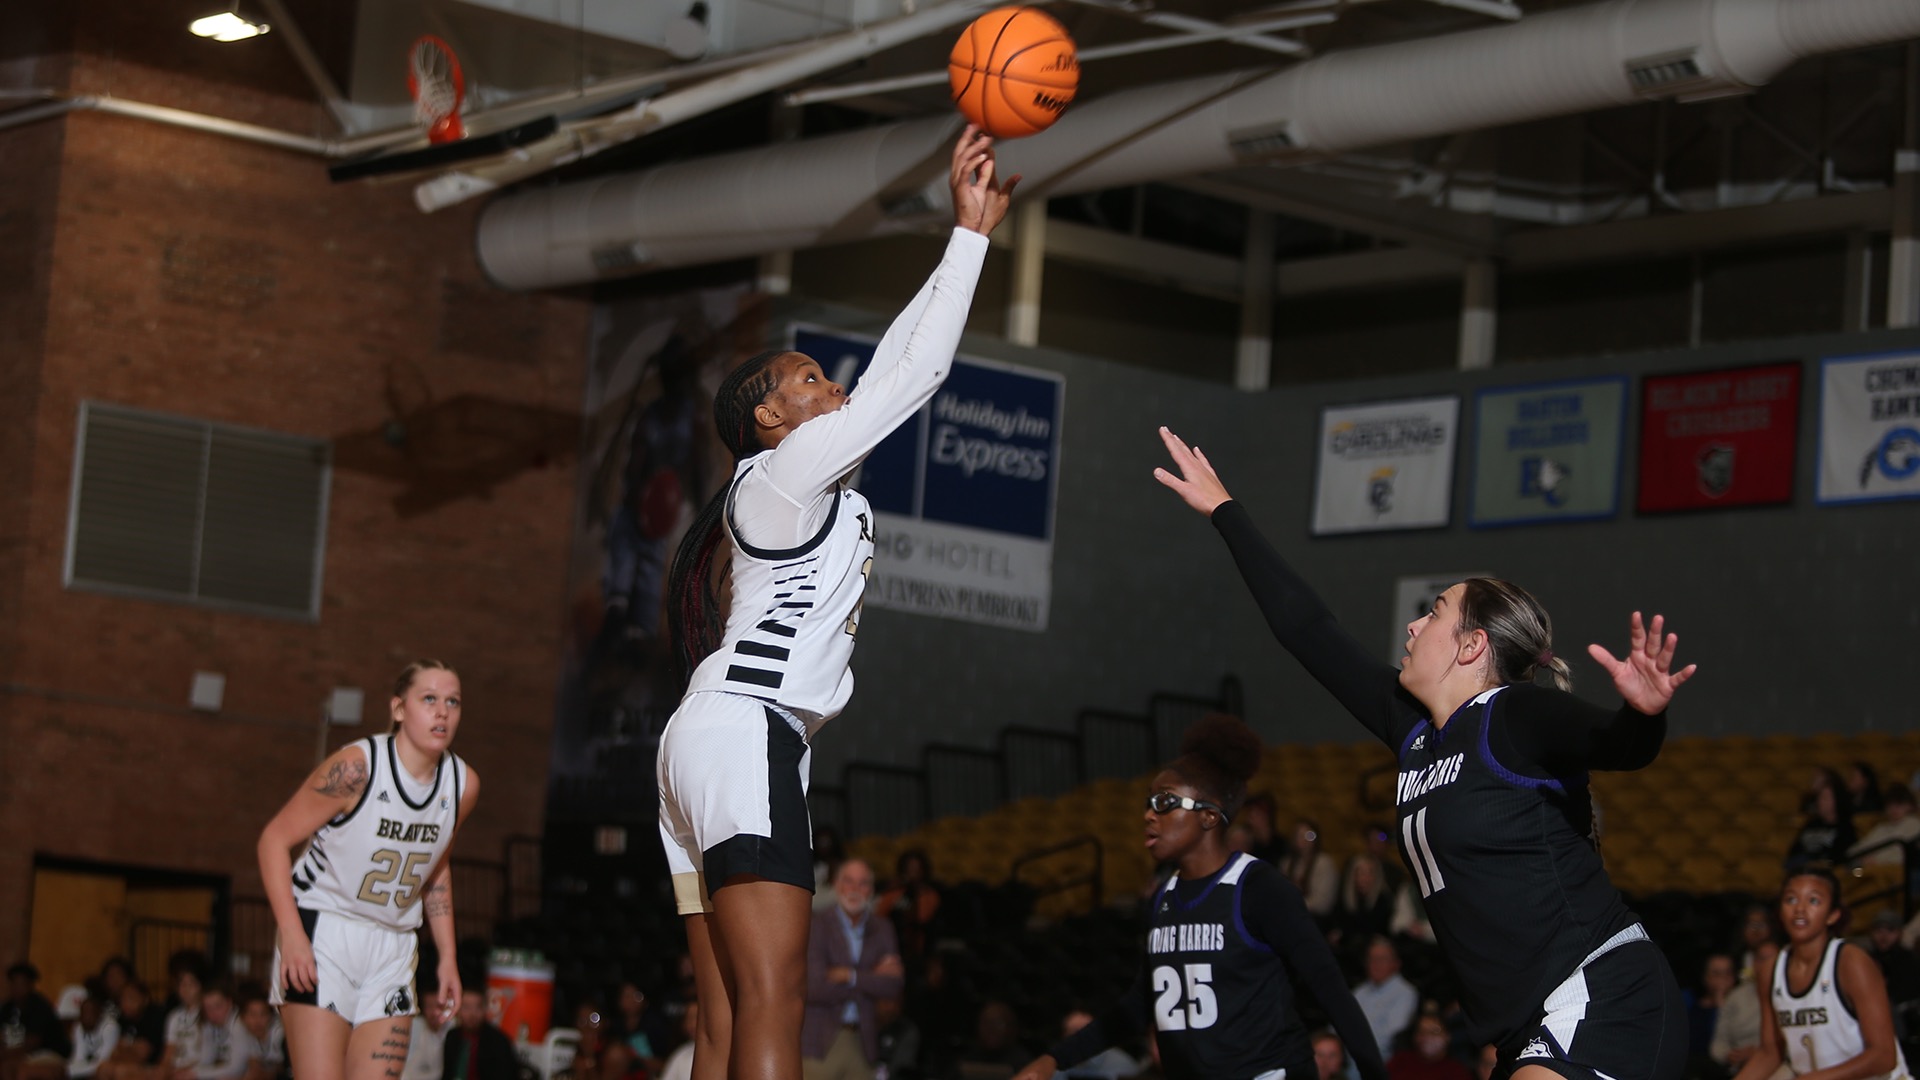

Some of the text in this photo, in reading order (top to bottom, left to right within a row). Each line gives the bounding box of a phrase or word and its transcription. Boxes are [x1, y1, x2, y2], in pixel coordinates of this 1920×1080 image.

[938, 394, 1050, 438] Holiday Inn
[933, 423, 1047, 481] Express
[925, 537, 1015, 579] HOTEL
[376, 816, 440, 844] BRAVES
[1402, 806, 1445, 898] 11
[357, 848, 432, 909] 25
[1179, 923, 1225, 952] HARRIS
[1152, 963, 1219, 1032] 25
